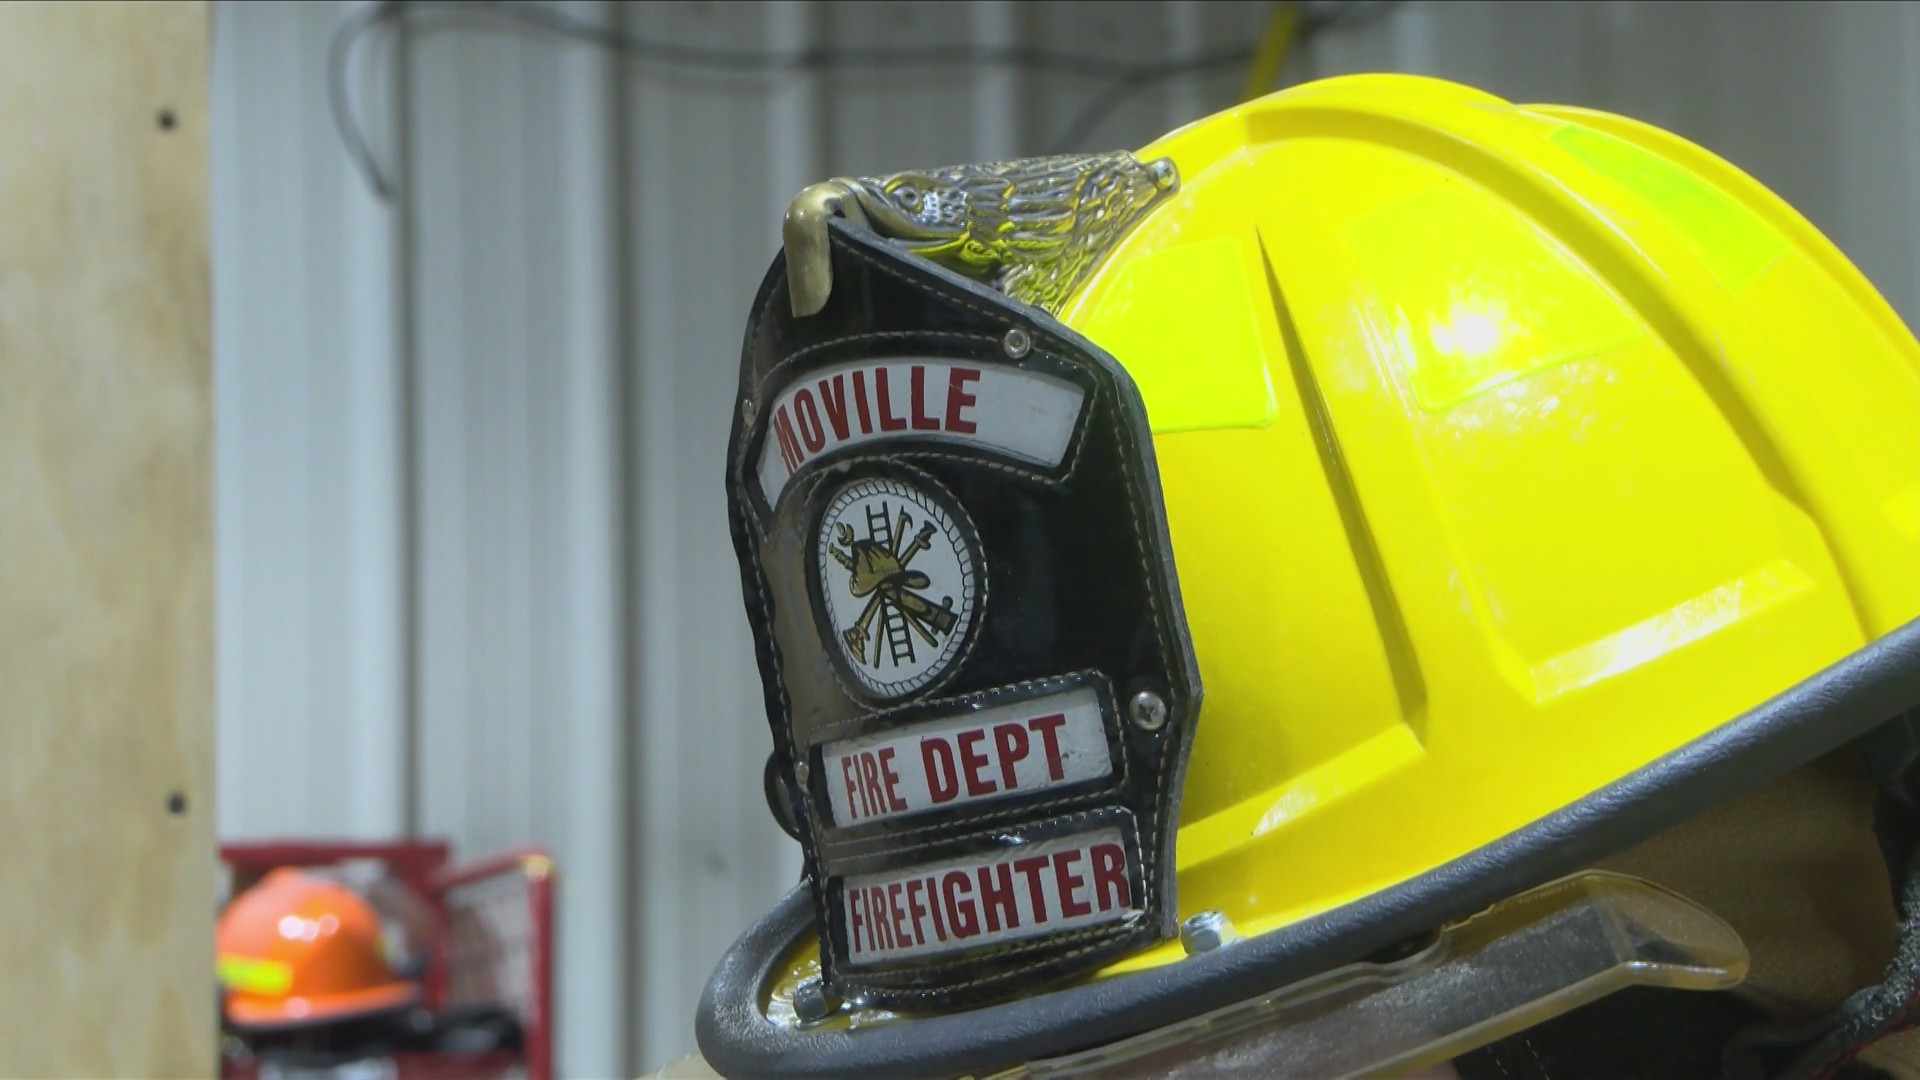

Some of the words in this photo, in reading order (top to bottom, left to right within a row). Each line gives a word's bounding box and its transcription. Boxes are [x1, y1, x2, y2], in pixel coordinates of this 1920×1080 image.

[773, 365, 981, 475] MOVILLE
[841, 746, 908, 819] FIRE
[920, 713, 1066, 804] DEPT
[849, 842, 1132, 953] FIREFIGHTER
